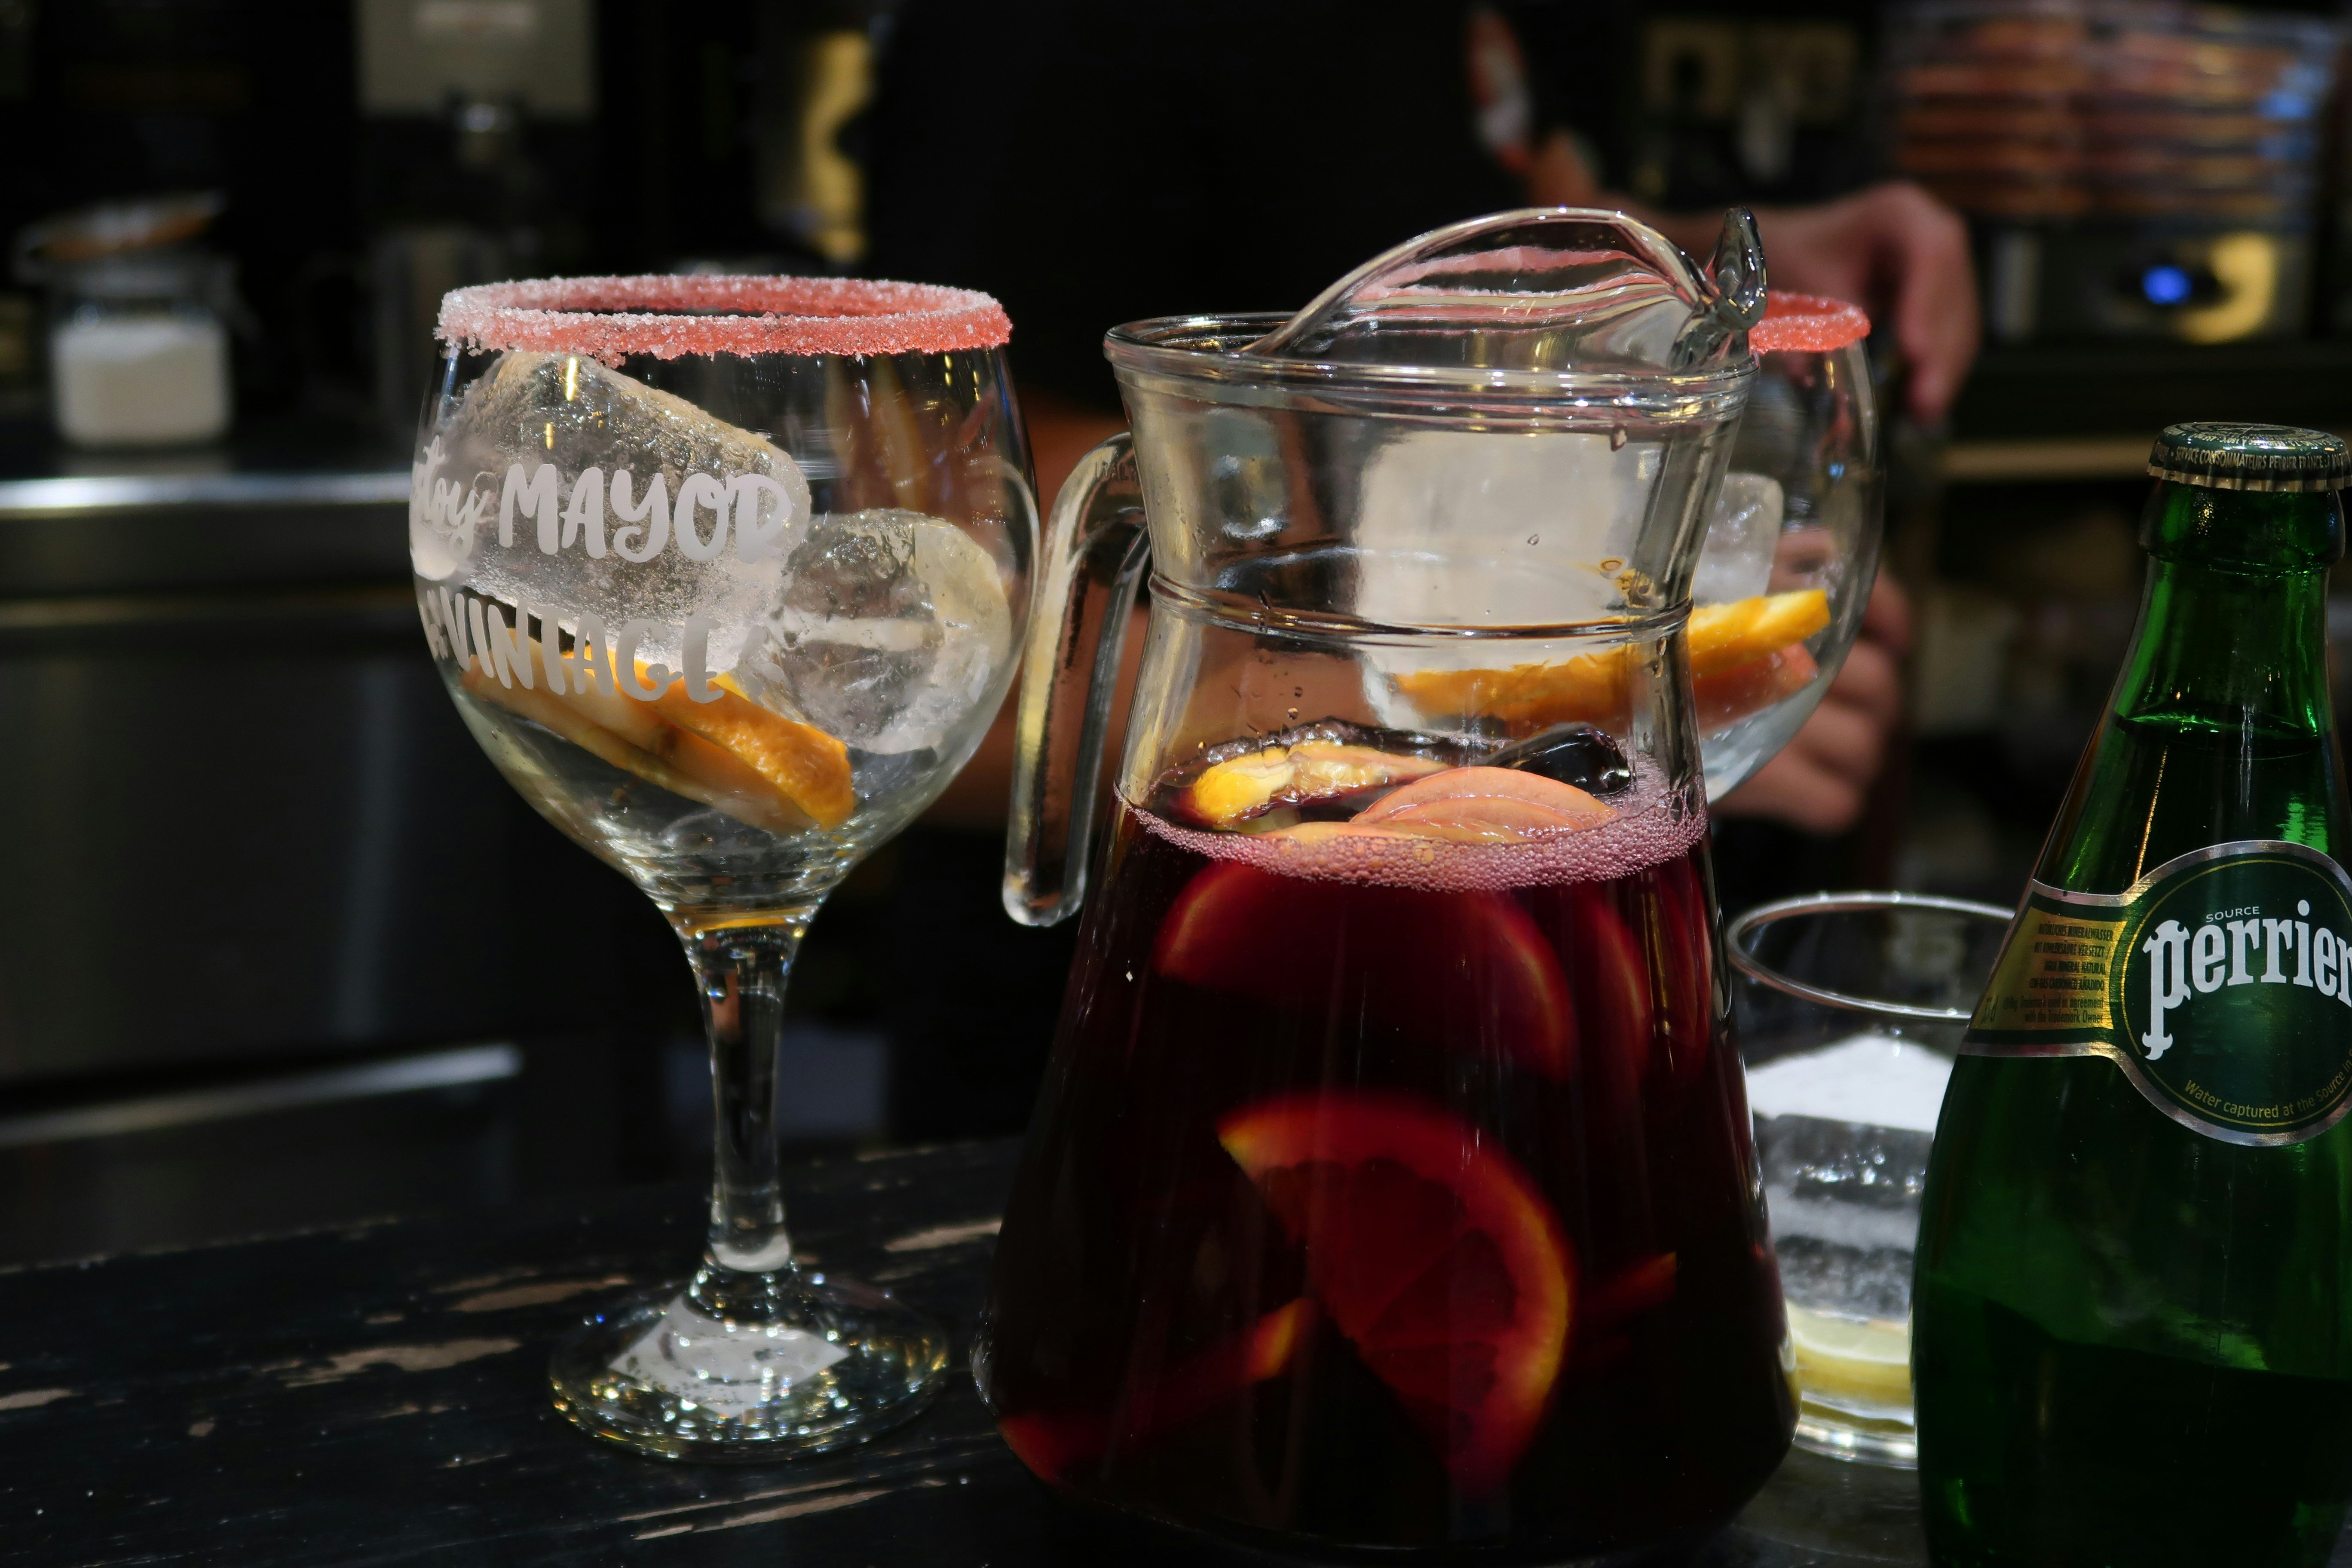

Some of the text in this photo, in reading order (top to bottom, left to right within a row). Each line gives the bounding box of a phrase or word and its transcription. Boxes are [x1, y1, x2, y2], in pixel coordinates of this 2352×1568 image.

[2175, 446, 2199, 464] SERVICE
[2199, 450, 2267, 471] CONSOMMATEURS
[2269, 456, 2297, 471] PERRIER
[2299, 455, 2324, 470] FRANCE
[439, 585, 725, 704] VINTAGE
[2205, 906, 2260, 923] SOURCE
[2068, 926, 2113, 941] MINERALWASSER
[2078, 944, 2105, 958] VERSETZT
[2082, 962, 2105, 975] NATURAL
[2142, 899, 2352, 1061] perrier
[2070, 996, 2104, 1011] agreement
[2048, 1009, 2081, 1023] Trademark
[2082, 1010, 2103, 1023] Owner
[2184, 1079, 2222, 1108] Water
[2223, 1101, 2278, 1118] captured
[2282, 1103, 2294, 1117] at
[2297, 1096, 2315, 1112] the
[2316, 1071, 2346, 1102] Source
